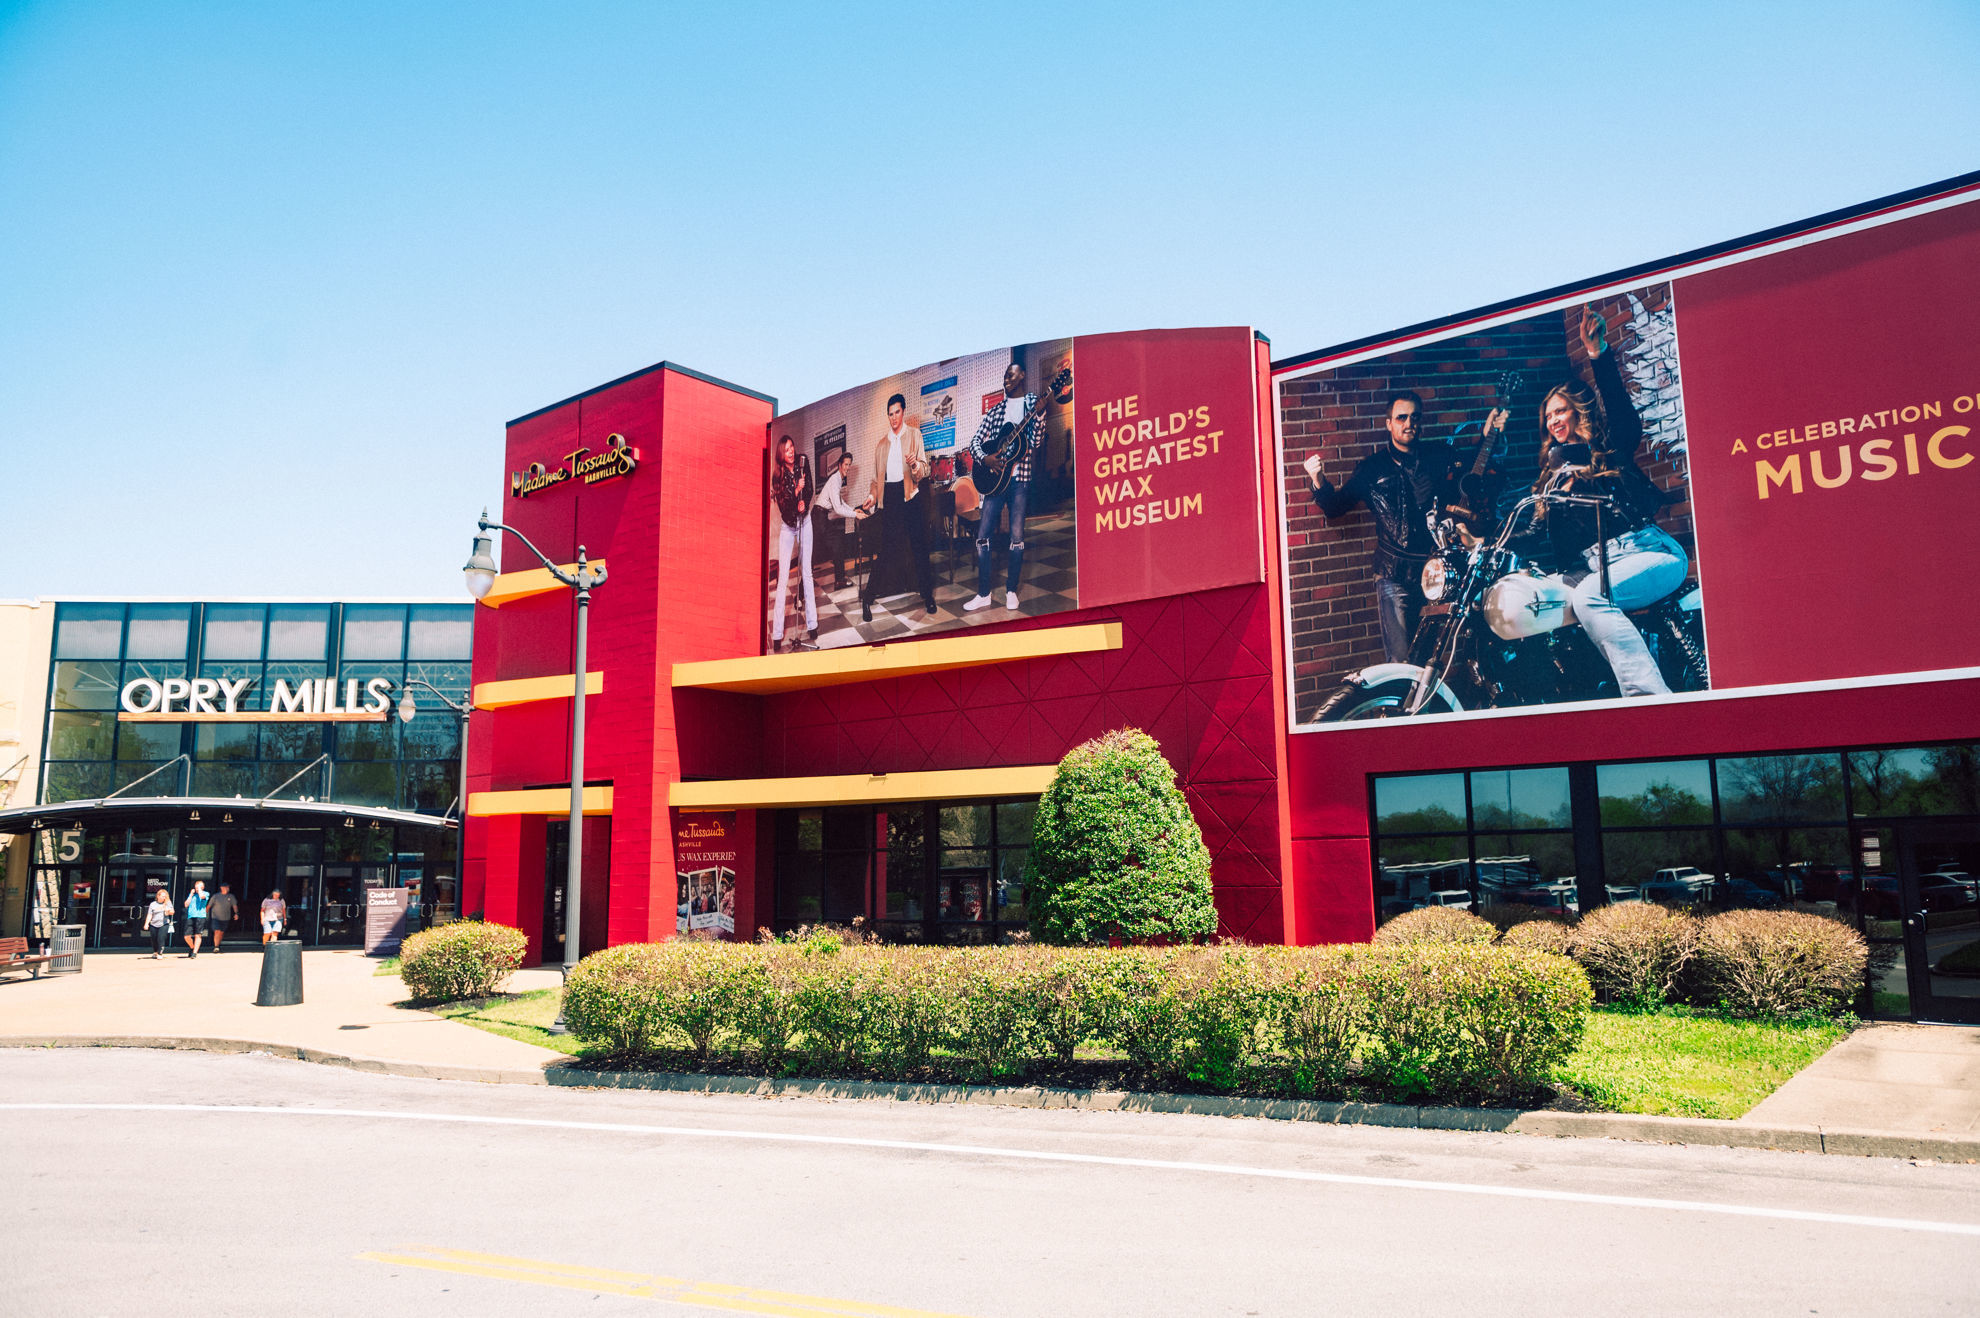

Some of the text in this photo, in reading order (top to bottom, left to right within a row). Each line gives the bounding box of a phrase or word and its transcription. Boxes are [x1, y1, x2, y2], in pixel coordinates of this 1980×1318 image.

[1092, 395, 1139, 425] THE
[1730, 392, 1980, 456] A CELEBRATION O
[1093, 406, 1211, 452] WORLD'S
[511, 433, 636, 498] Madame Tussauds
[1093, 430, 1224, 478] GREATEST
[1755, 425, 1976, 500] MUSIC
[585, 465, 617, 485] NASHVILLE
[1094, 474, 1154, 506] WAX
[1095, 493, 1203, 534] MUSEUM
[121, 677, 392, 713] OPRY MILLS
[688, 820, 725, 838] Tussauds
[58, 831, 81, 862] 5
[686, 852, 702, 862] WAX
[369, 890, 396, 899] Code of
[369, 898, 398, 906] Conduct
